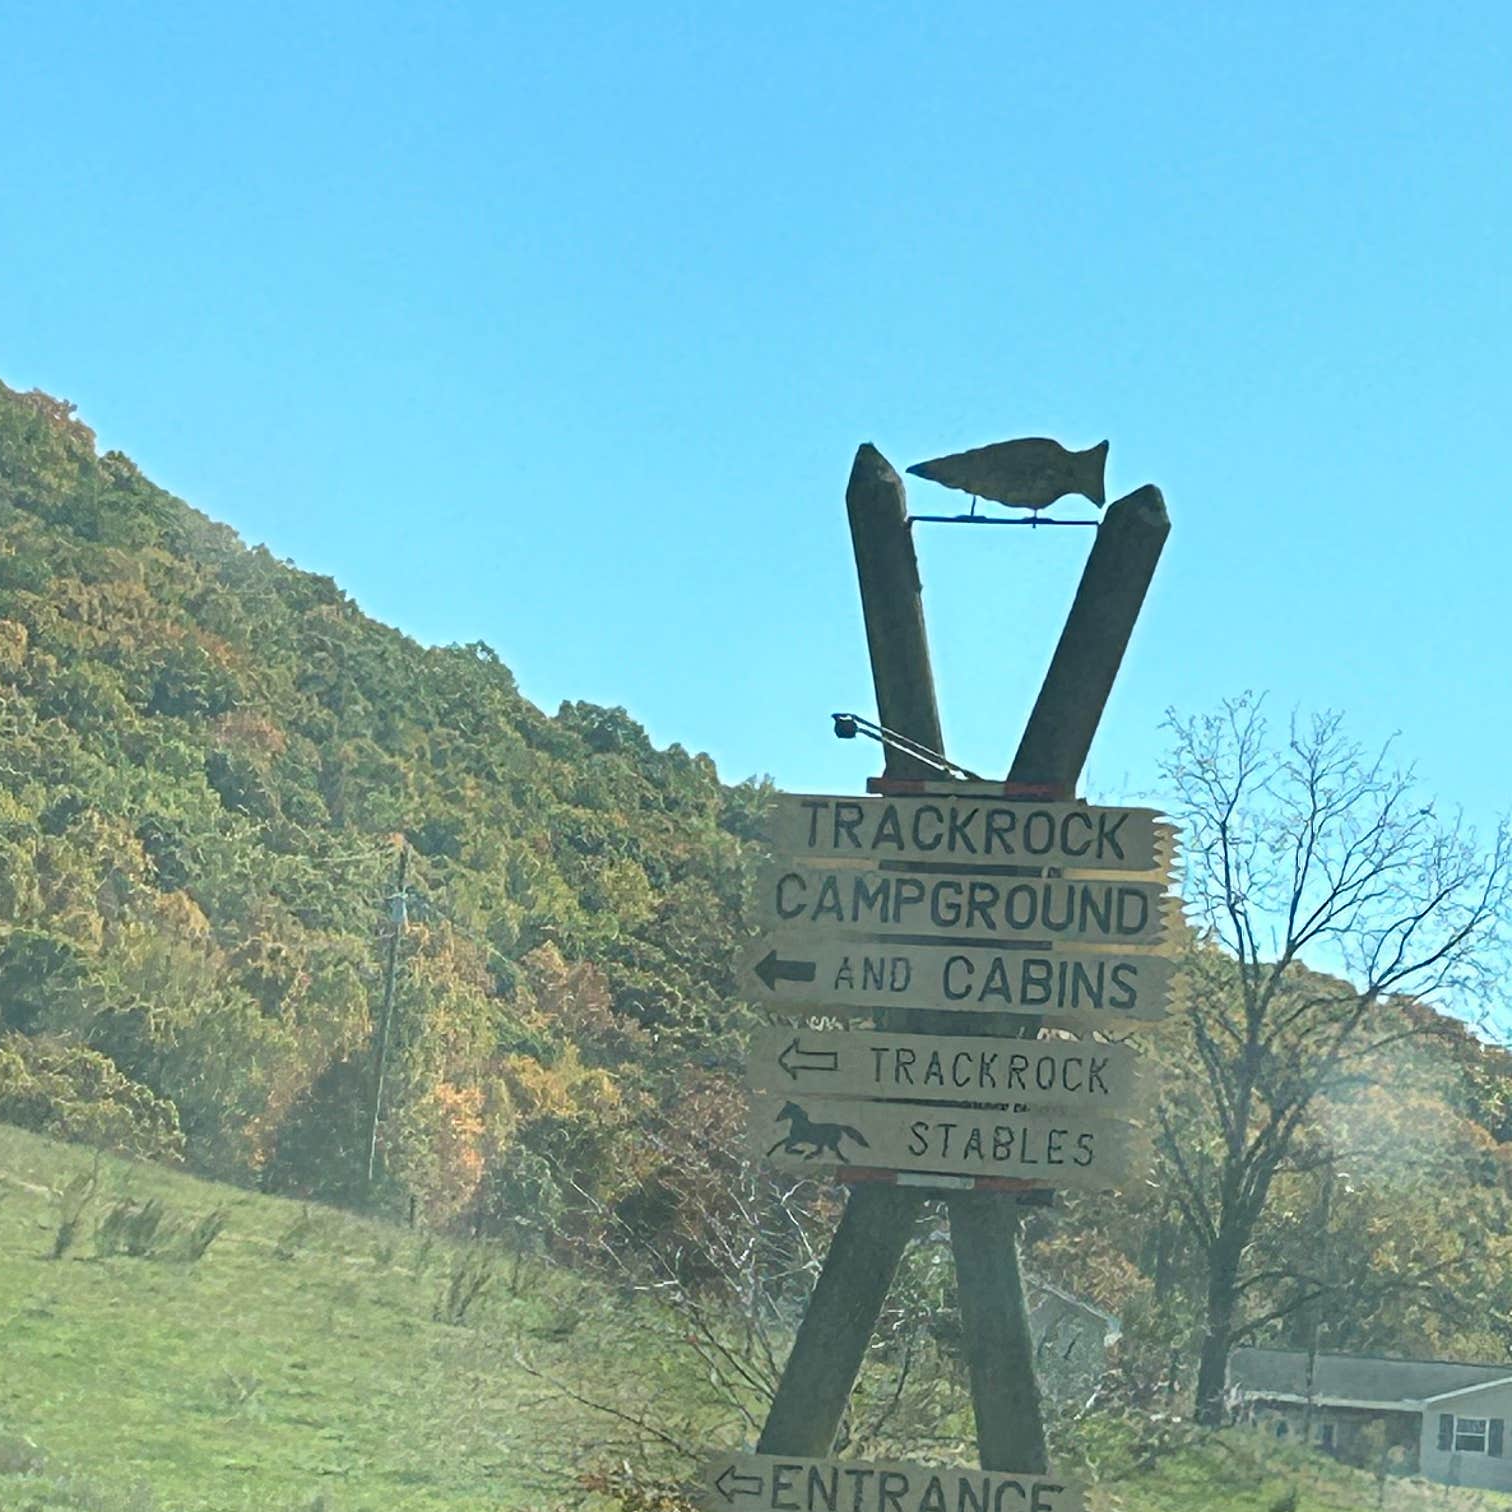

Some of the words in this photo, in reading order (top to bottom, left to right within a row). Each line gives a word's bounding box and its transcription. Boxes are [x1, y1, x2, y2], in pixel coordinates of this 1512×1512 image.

[801, 801, 1130, 860] TRACKROCK
[775, 873, 1149, 935] CAMPGROUND
[834, 956, 911, 992] AND
[943, 955, 1138, 1009] CABINS
[870, 1047, 1109, 1095] TRACKROCK
[908, 1121, 1094, 1167] STABLES
